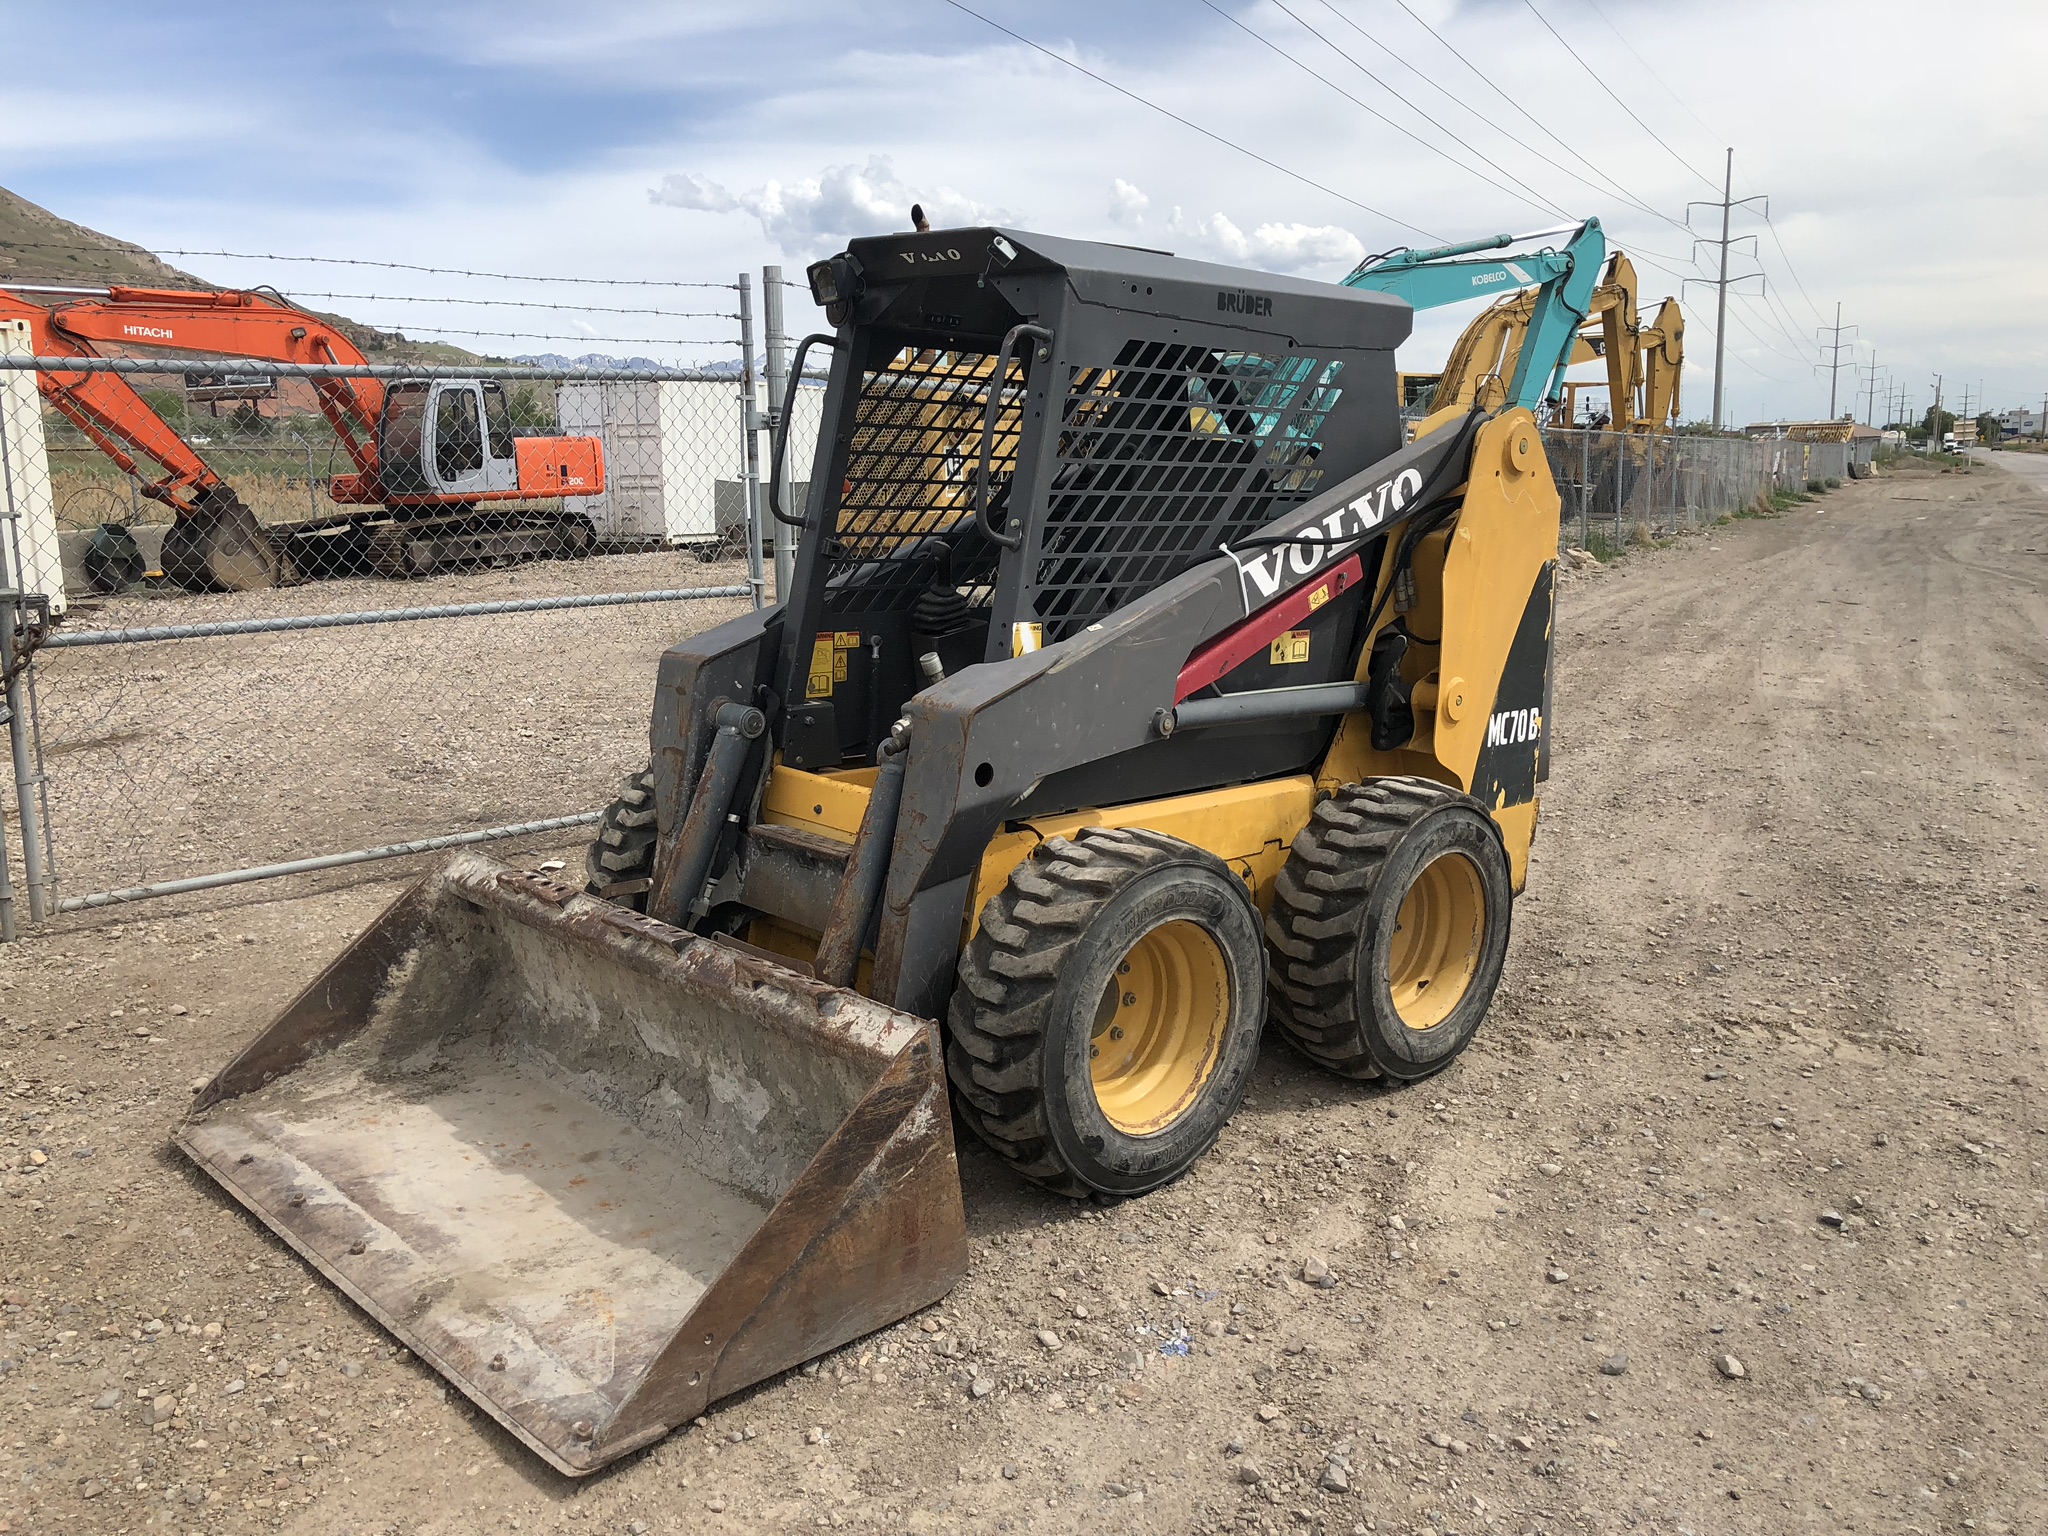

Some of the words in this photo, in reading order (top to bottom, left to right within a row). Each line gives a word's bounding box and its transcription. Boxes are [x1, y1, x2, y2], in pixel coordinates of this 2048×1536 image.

[1471, 271, 1507, 286] KOBELCO
[1217, 288, 1273, 317] BRÜDER
[123, 324, 173, 339] HITACHI
[1240, 468, 1423, 597] VOLVO
[1487, 707, 1540, 748] MC70B
